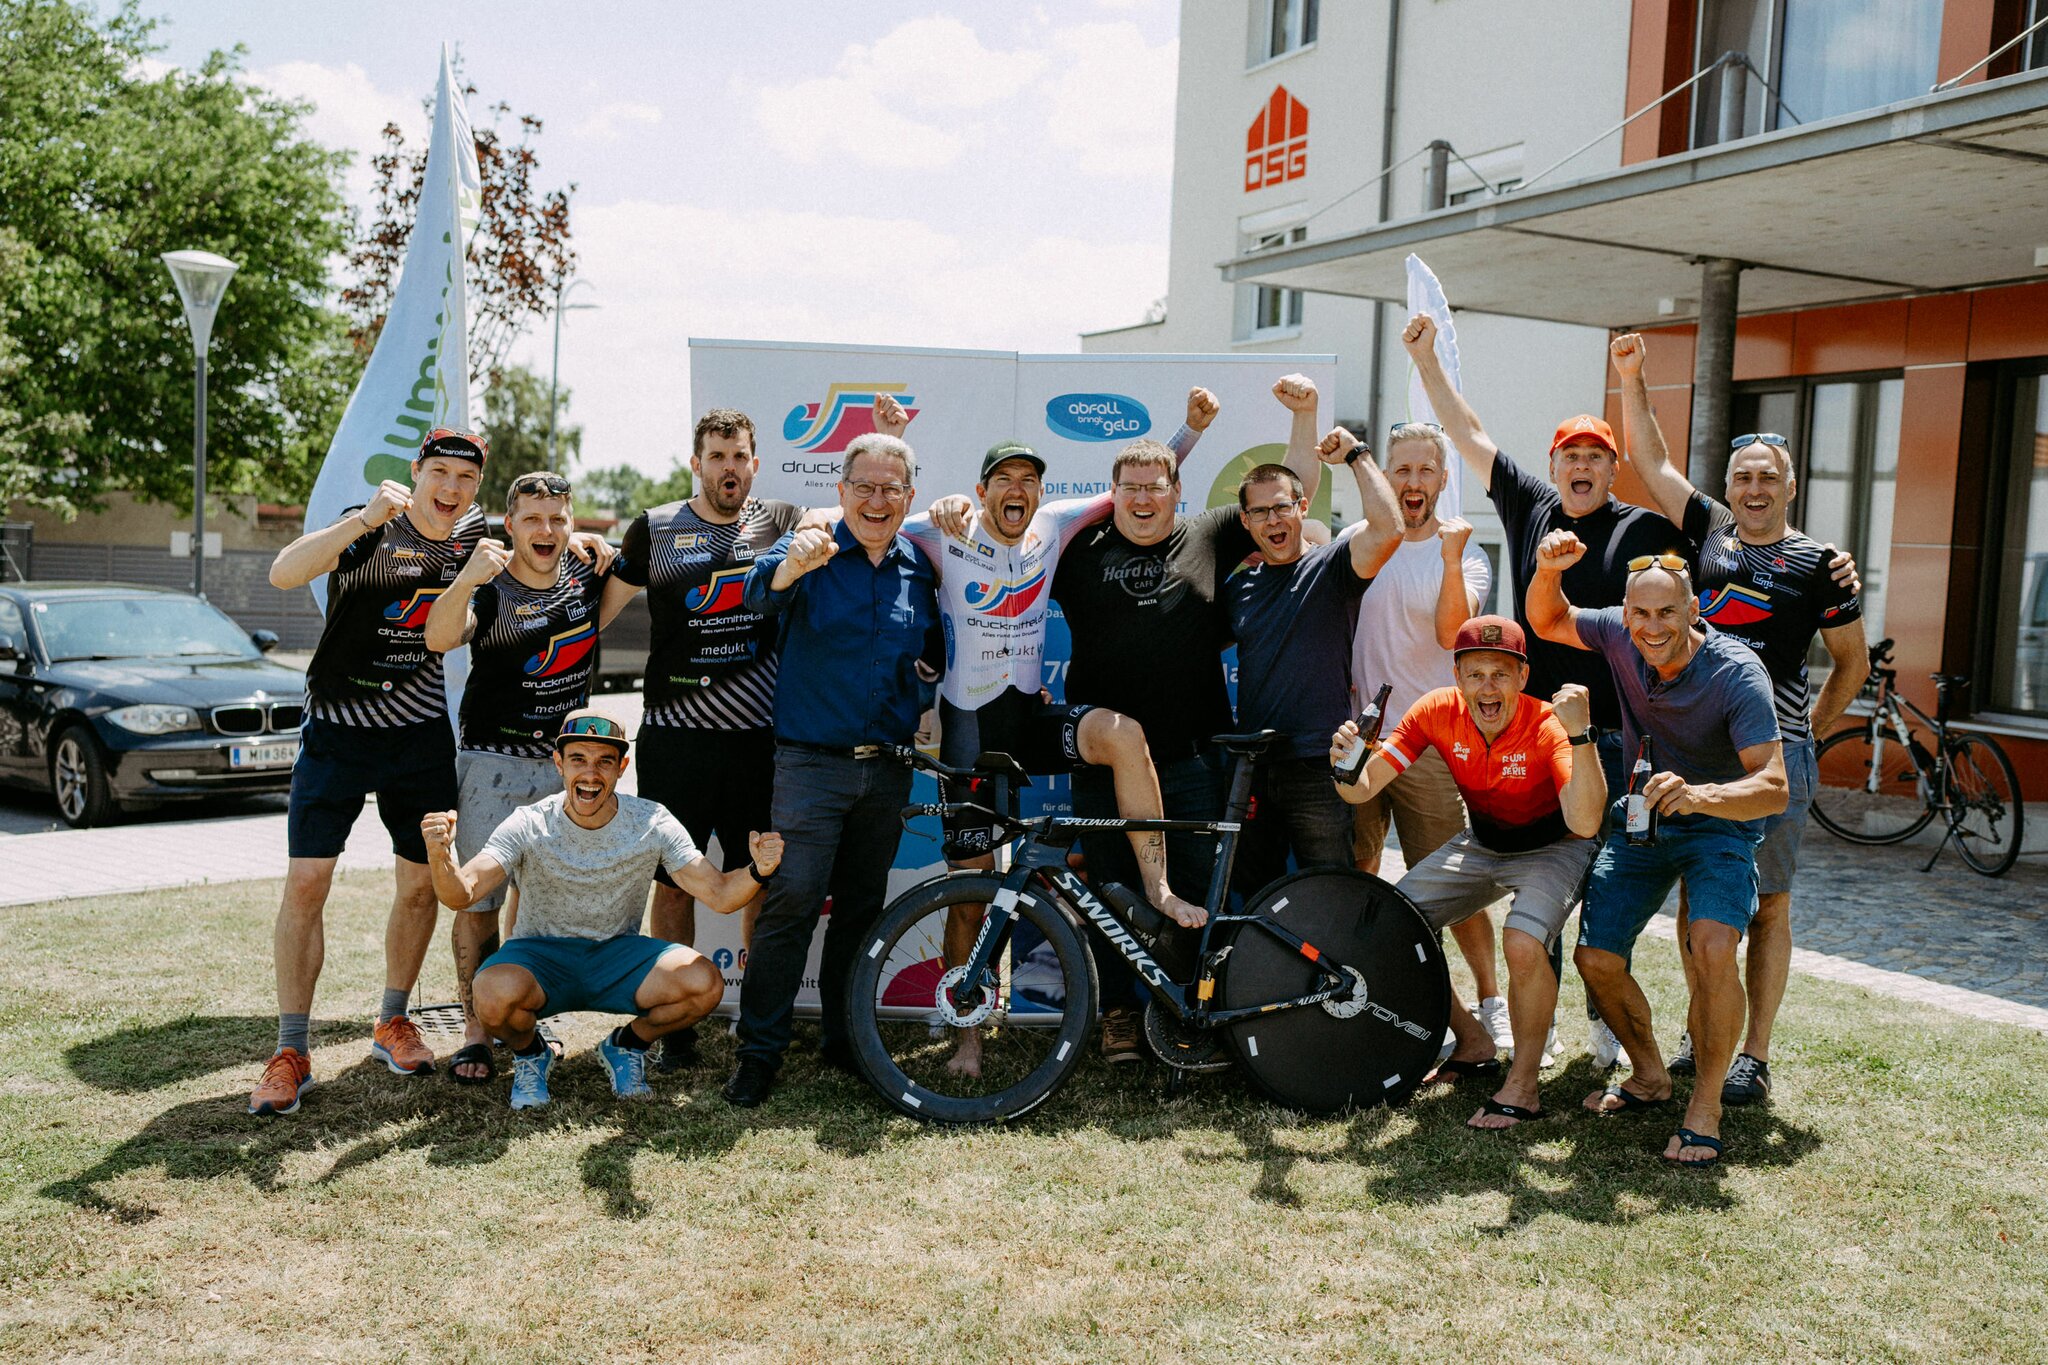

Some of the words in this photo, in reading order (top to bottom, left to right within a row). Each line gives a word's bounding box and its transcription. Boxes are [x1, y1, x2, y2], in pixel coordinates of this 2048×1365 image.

[805, 480, 824, 488] Alles
[1045, 482, 1068, 495] DIE
[1072, 482, 1112, 494] NATU
[1102, 563, 1141, 582] Hard
[1137, 598, 1158, 607] MALTA
[701, 642, 745, 656] medukt
[386, 651, 428, 663] meduk
[1042, 803, 1056, 811] für
[1057, 803, 1072, 811] die
[1060, 818, 1128, 827] SPECIALIZED
[1053, 871, 1171, 987] S-WORKS
[961, 916, 992, 983] SPECIALIZED
[1362, 1001, 1432, 1041] roval
